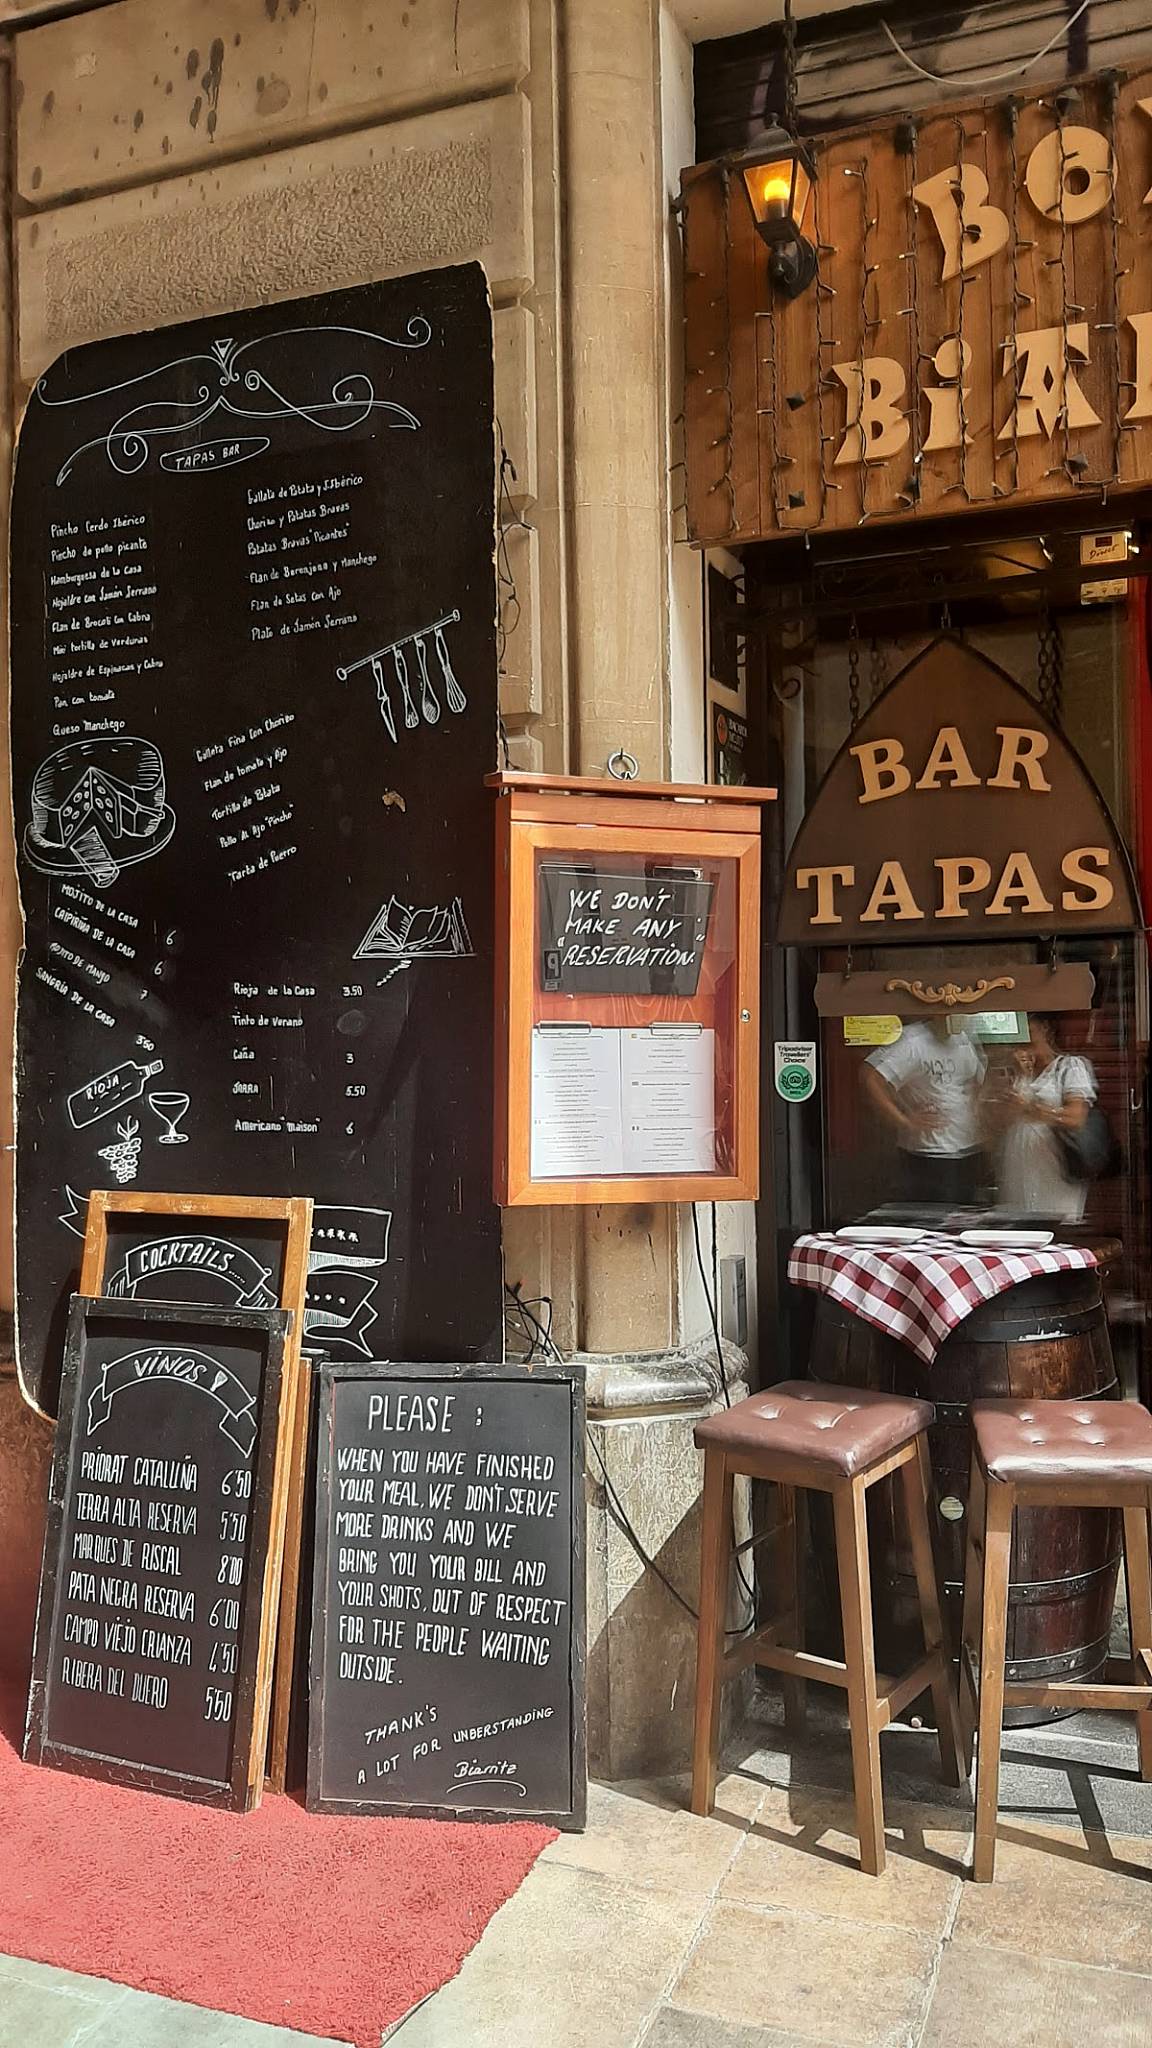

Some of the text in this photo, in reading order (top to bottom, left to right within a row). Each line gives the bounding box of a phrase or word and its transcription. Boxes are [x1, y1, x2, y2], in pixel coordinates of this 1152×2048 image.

[912, 97, 1152, 280] BO
[175, 443, 241, 470] TAPAS BAR
[51, 522, 78, 538] Pincho
[51, 546, 76, 562] Pincho
[82, 545, 92, 557] de
[273, 595, 283, 607] de
[280, 623, 291, 636] de
[52, 724, 80, 736] Queso
[224, 770, 235, 783] de
[849, 726, 1051, 804] BAR
[242, 796, 253, 808] de
[258, 857, 269, 870] de
[567, 888, 602, 911] WE
[796, 847, 1114, 925] TAPAS
[61, 883, 177, 945] MOJITO DE LA CASA 6
[565, 917, 683, 940] MAKE ANY
[72, 956, 85, 968] DE
[92, 927, 105, 941] DE
[105, 937, 115, 949] LA
[116, 942, 137, 959] CASA
[154, 961, 164, 976] 6
[233, 982, 258, 998] Rioja
[267, 986, 278, 996] de
[71, 991, 84, 1005] DE
[84, 1001, 95, 1014] LA
[95, 1009, 116, 1028] CASA
[232, 1011, 255, 1026] Tinto
[258, 1014, 269, 1026] de
[233, 1046, 355, 1064] Caña 3
[86, 1074, 120, 1100] RIOJA
[368, 1394, 456, 1432] PLEASE
[337, 1448, 554, 1481] WHEN YOU HAVE FINISHED
[76, 1493, 109, 1523] TERRA
[112, 1498, 141, 1528] ALTA
[147, 1502, 197, 1535] RESERVA
[339, 1479, 374, 1503] YOUR
[429, 1483, 456, 1510] WE
[505, 1487, 560, 1518] SERVE
[335, 1511, 517, 1549] MORE DRINKS AND WE
[73, 1532, 118, 1564] MARQUES
[121, 1538, 135, 1567] DE
[141, 1543, 181, 1576] RISCAL
[338, 1548, 547, 1587] BRING YOU YOUR BILL AND
[68, 1570, 96, 1602] PATA
[100, 1577, 139, 1610] NEGRA
[144, 1585, 195, 1623] RESERVA
[338, 1581, 374, 1607] YOUR
[432, 1588, 463, 1615] OUT
[469, 1590, 488, 1616] OF
[496, 1593, 567, 1626] RESPECT
[64, 1613, 99, 1648] CAMPO
[141, 1629, 192, 1666] CRIANZA
[339, 1615, 550, 1666] FOR THE PEOPLE WAITING
[62, 1657, 104, 1692] RIBERA
[107, 1667, 125, 1697] DEL
[131, 1673, 169, 1709] DUERO
[364, 1704, 437, 1745] THANK'S
[357, 1769, 367, 1784] A
[376, 1754, 401, 1777] LOT
[412, 1738, 442, 1761] FOR
